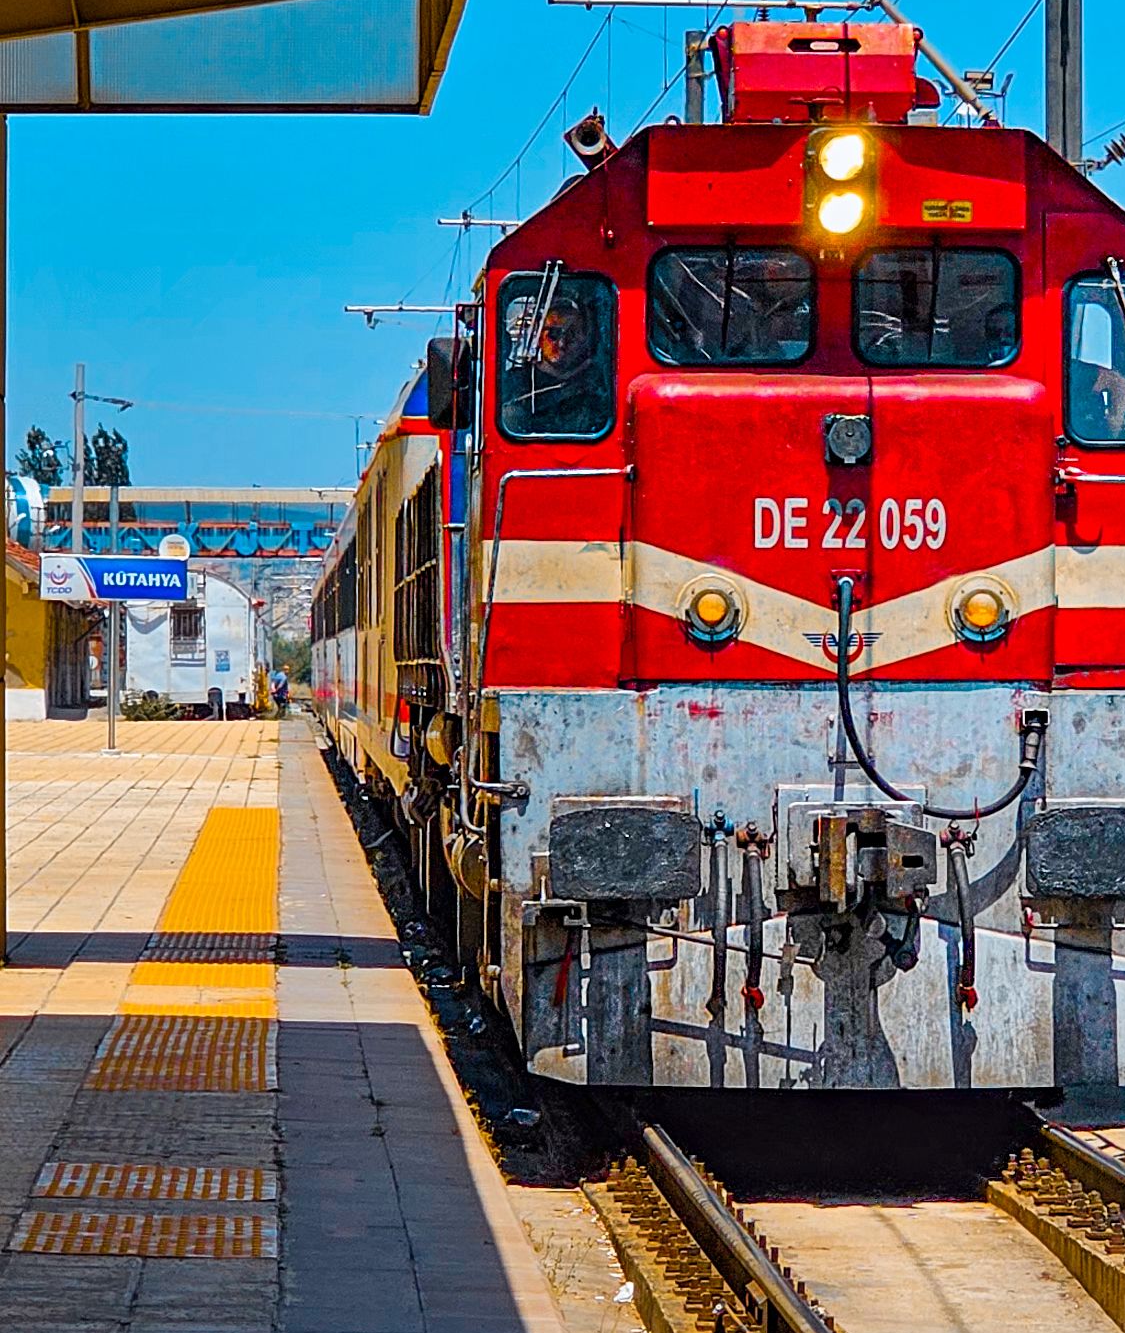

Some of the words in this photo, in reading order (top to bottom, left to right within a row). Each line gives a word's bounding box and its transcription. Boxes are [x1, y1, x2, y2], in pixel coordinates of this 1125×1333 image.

[754, 497, 809, 549] DE
[821, 497, 866, 549] 22
[879, 497, 947, 550] 059
[103, 570, 182, 588] KÜTAHYA
[46, 586, 73, 595] TCDD
